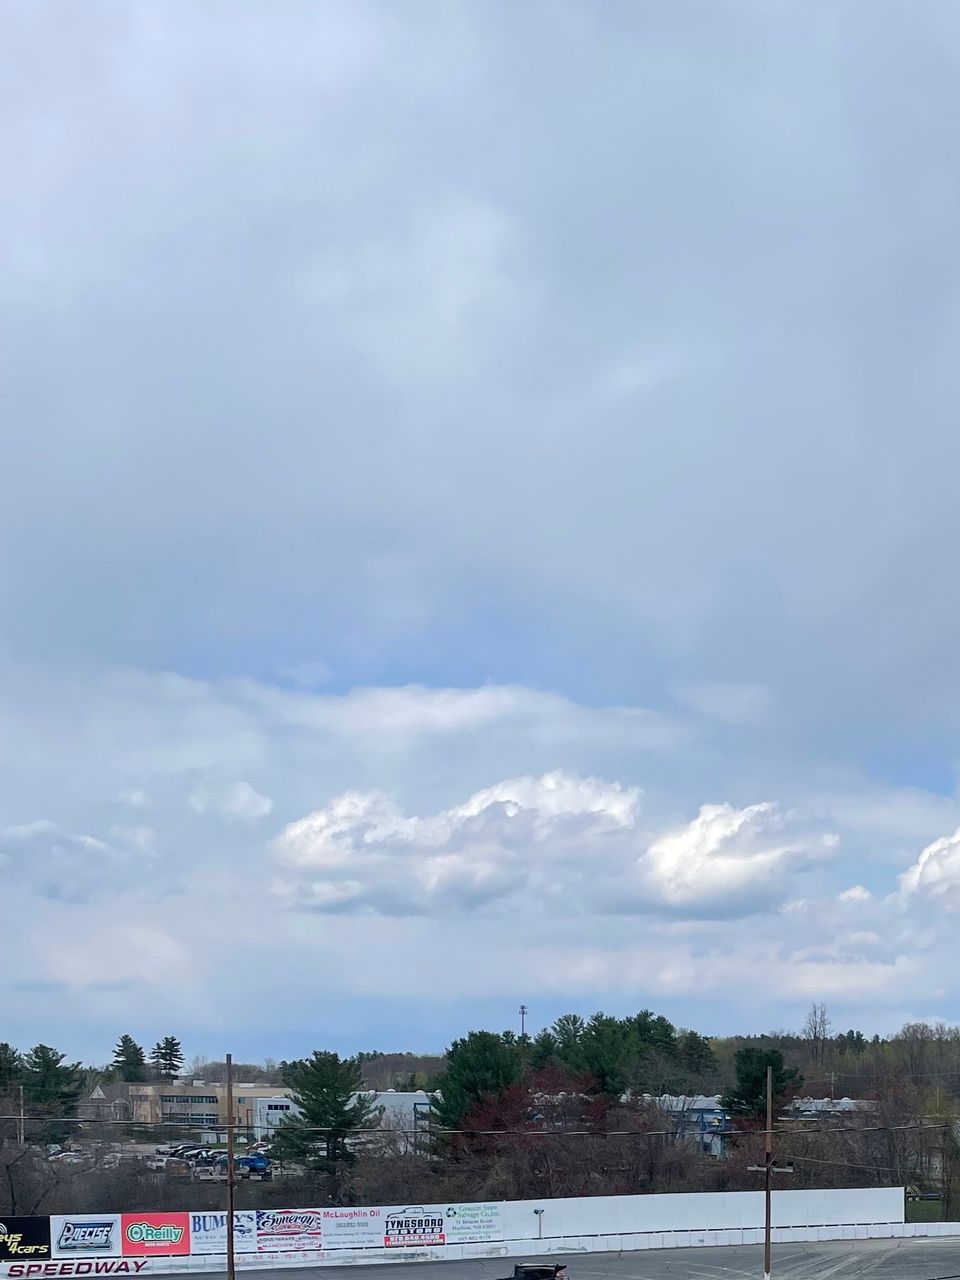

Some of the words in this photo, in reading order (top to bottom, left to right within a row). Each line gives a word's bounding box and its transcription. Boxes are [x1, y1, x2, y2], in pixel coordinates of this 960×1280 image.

[261, 1212, 318, 1230] Synergy
[323, 1210, 368, 1219] McLaughlin
[369, 1209, 380, 1217] Oil
[192, 1214, 254, 1233] BUMY'S
[384, 1218, 443, 1229] TYNGSBORO
[60, 1222, 111, 1246] PRECISE
[129, 1225, 182, 1241] O'Reilly
[8, 1242, 49, 1254] 4cars
[8, 1261, 148, 1277] SPEEDWAY
